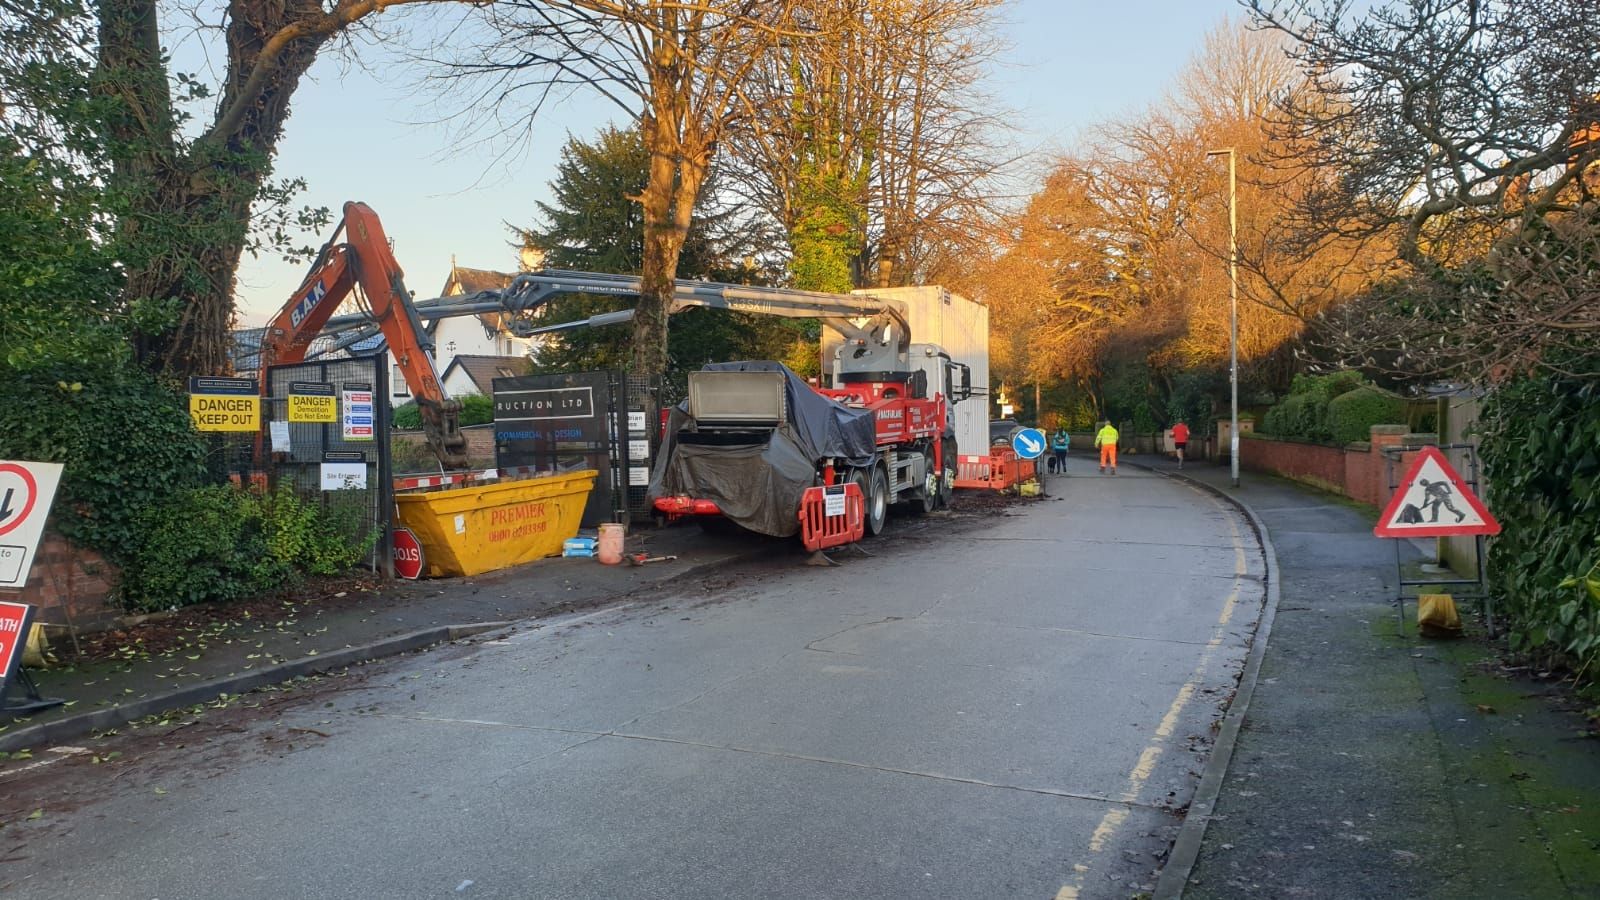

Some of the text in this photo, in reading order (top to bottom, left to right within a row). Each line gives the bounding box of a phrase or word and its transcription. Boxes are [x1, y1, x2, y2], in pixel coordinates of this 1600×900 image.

[199, 399, 253, 412] DANGER
[293, 396, 331, 406] DANGER
[562, 398, 583, 408] LTD
[199, 414, 253, 425] KEEP OUT
[491, 503, 545, 525] PREMIER
